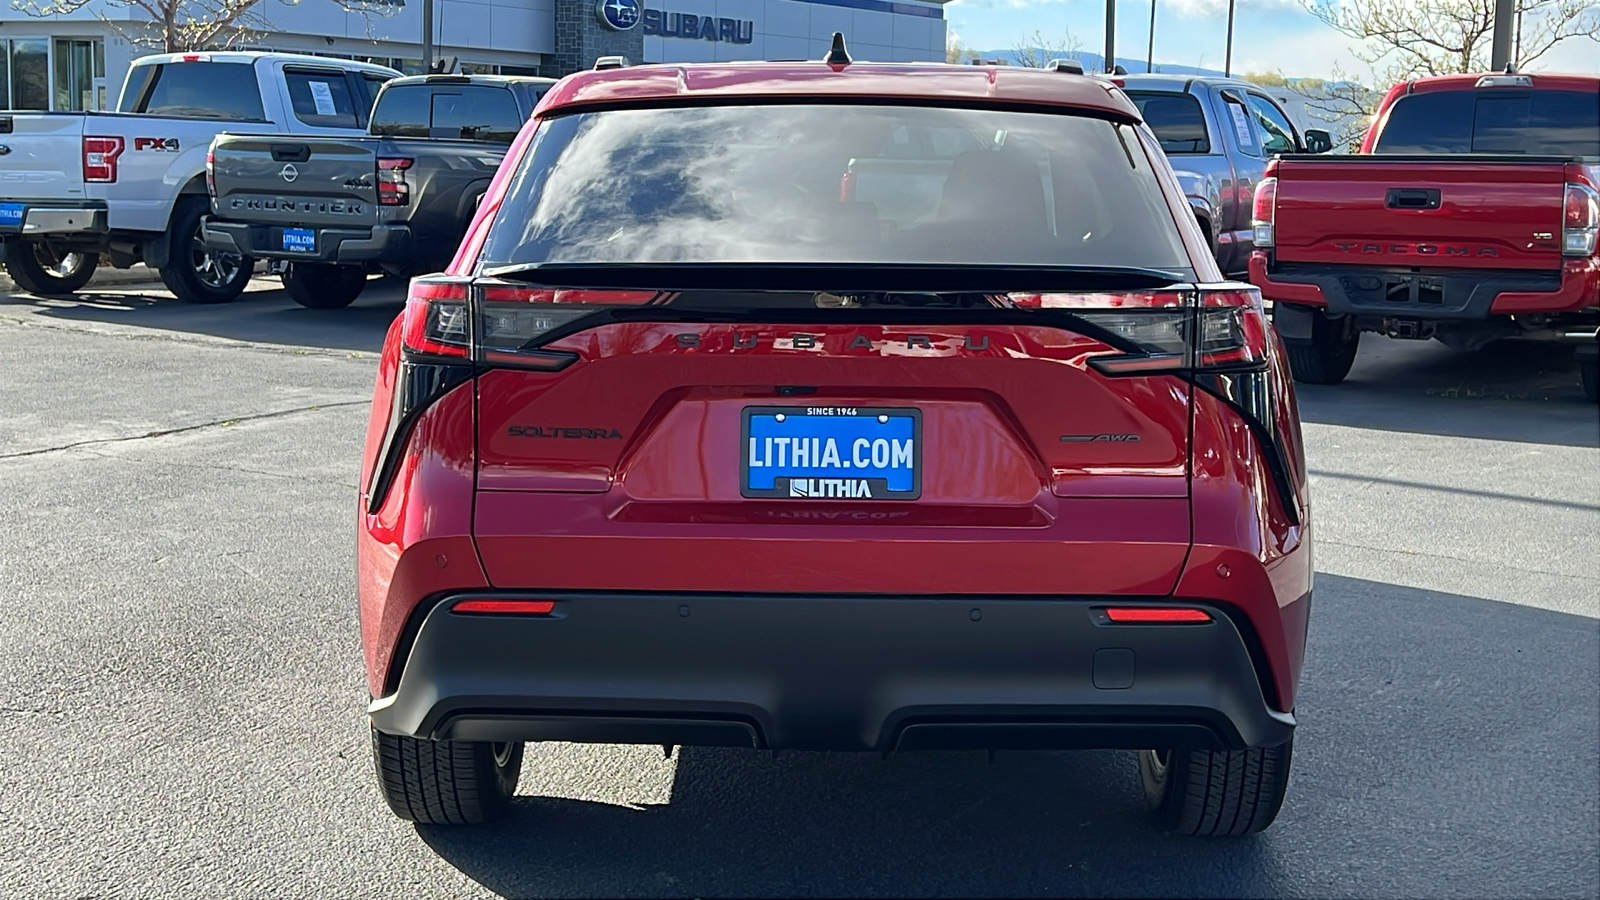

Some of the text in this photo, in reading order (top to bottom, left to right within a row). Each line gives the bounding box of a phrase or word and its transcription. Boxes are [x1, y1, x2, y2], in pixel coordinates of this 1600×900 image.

[643, 9, 753, 44] SUBARU
[134, 137, 180, 151] FX4
[231, 199, 363, 215] FRONTIER
[282, 234, 315, 245] LITHIA.COM
[1331, 242, 1499, 257] TACOMA
[676, 333, 989, 350] SUBARU
[807, 407, 857, 416] SINCE 1946
[507, 426, 623, 439] SOLTERRA
[1091, 433, 1141, 442] AWD
[749, 437, 914, 469] LITHIA.COM
[808, 479, 872, 498] LITHIA
